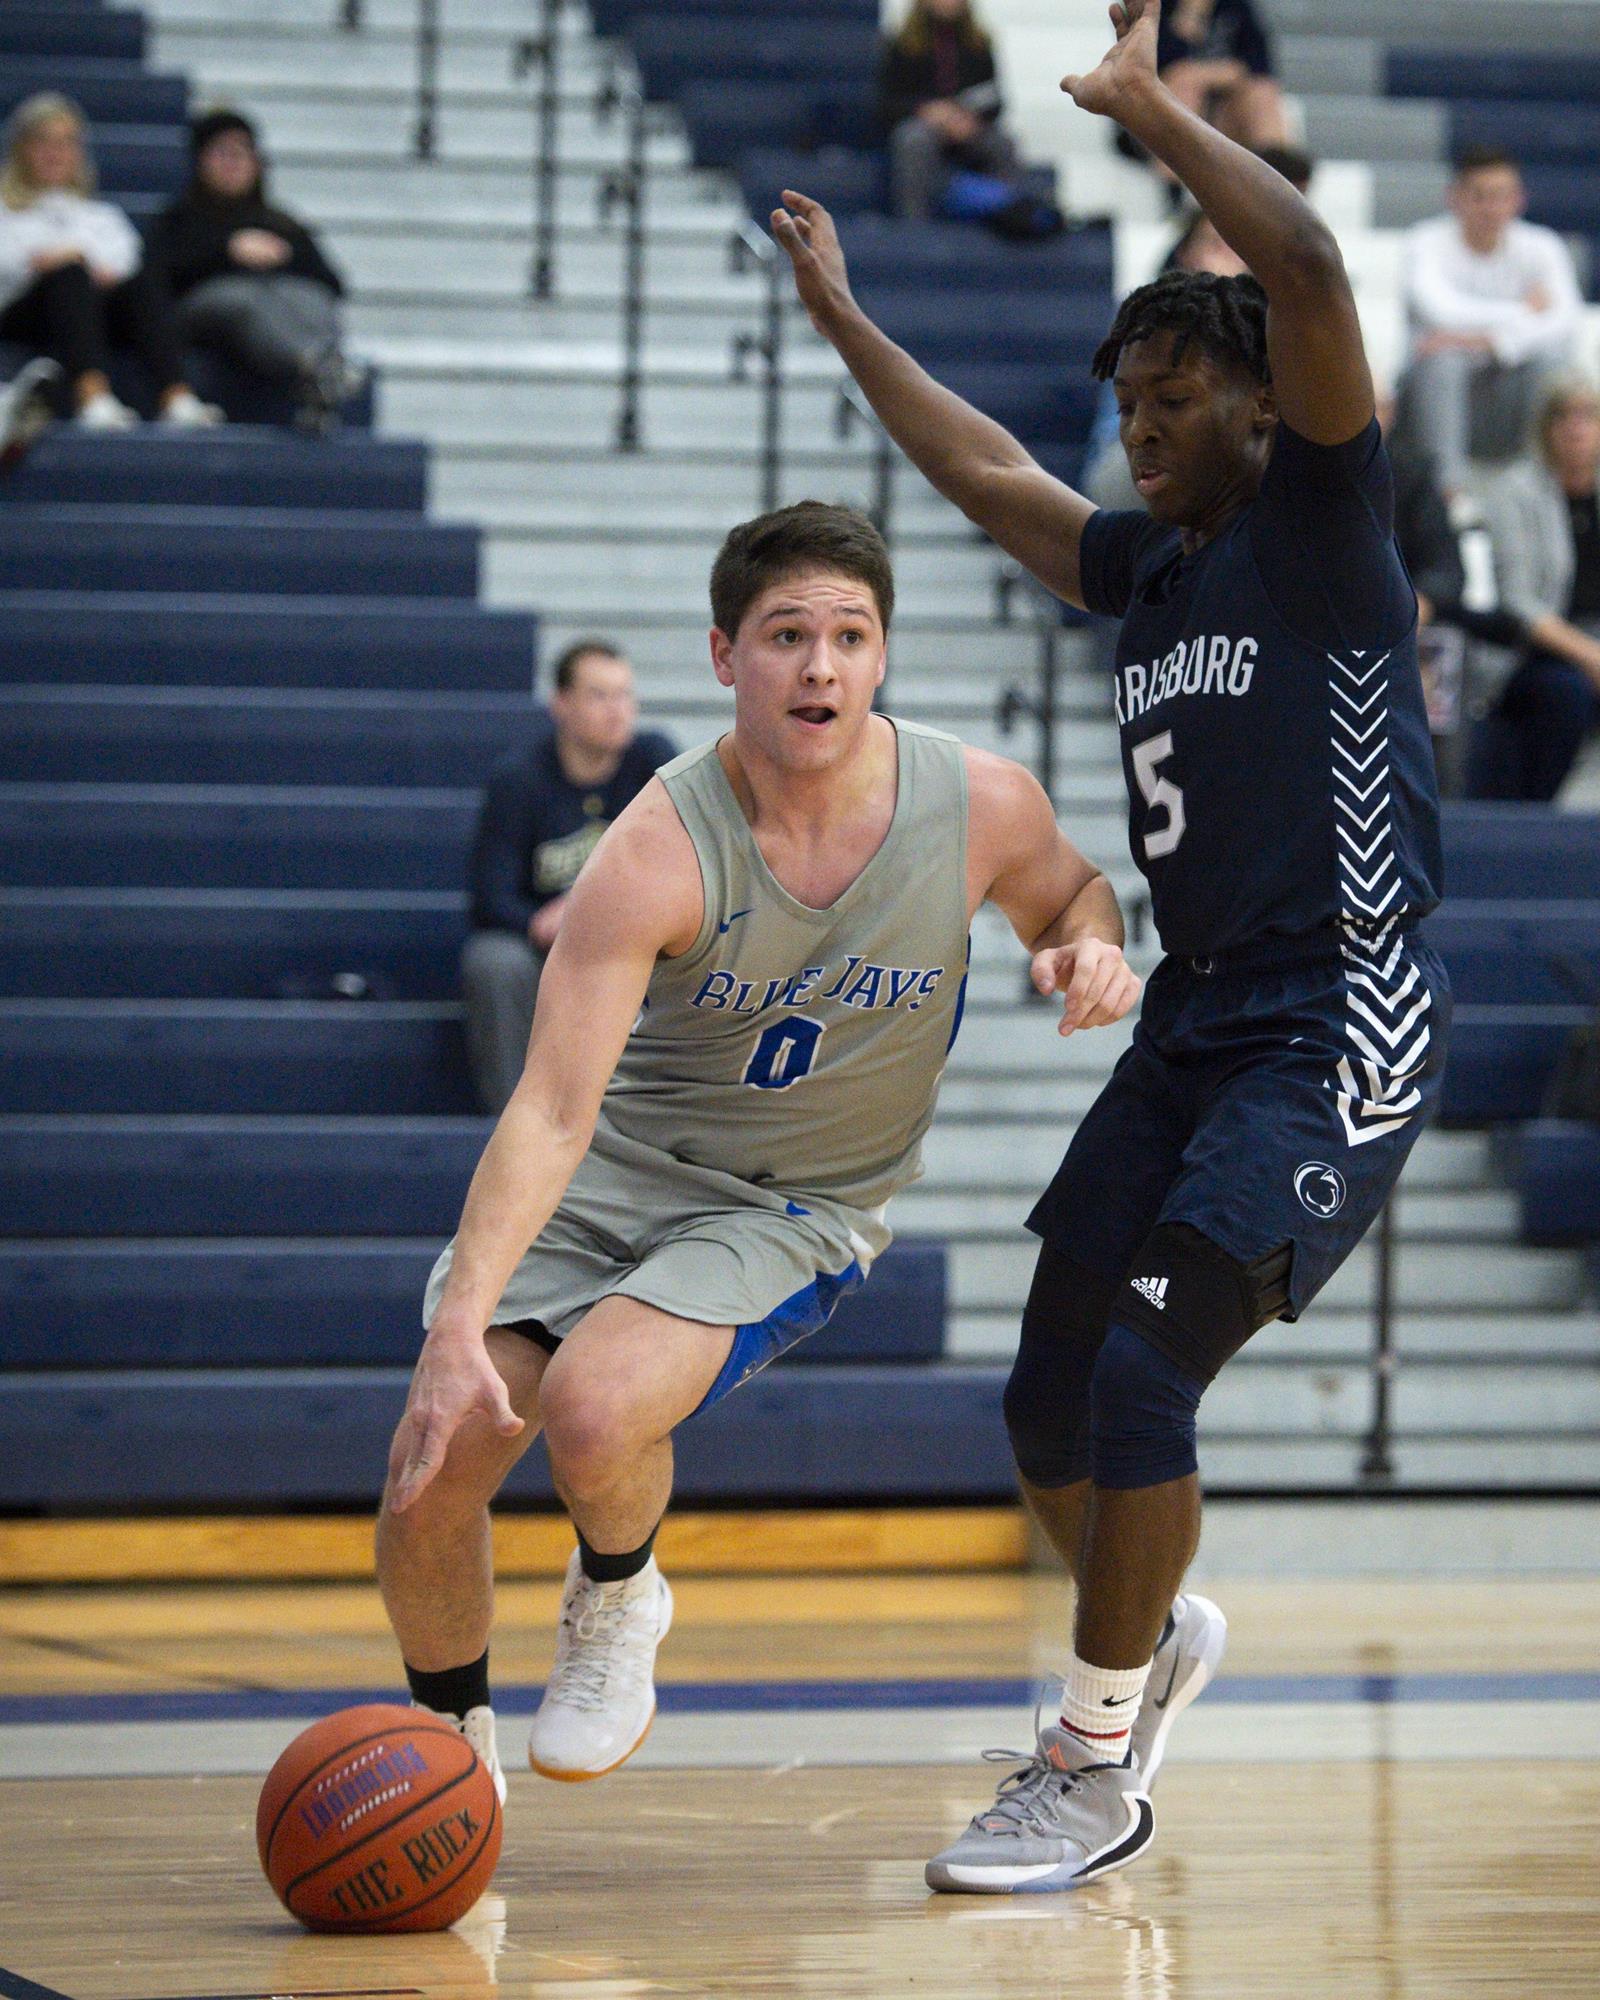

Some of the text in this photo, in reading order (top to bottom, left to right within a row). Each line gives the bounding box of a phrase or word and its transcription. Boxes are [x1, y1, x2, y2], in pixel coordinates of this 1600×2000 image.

[1131, 729, 1187, 860] 5
[688, 955, 945, 1014] BLUE JAYS
[740, 1012, 827, 1092] 0
[1131, 1278, 1166, 1310] adidas
[328, 1807, 481, 1913] THE ROCK
